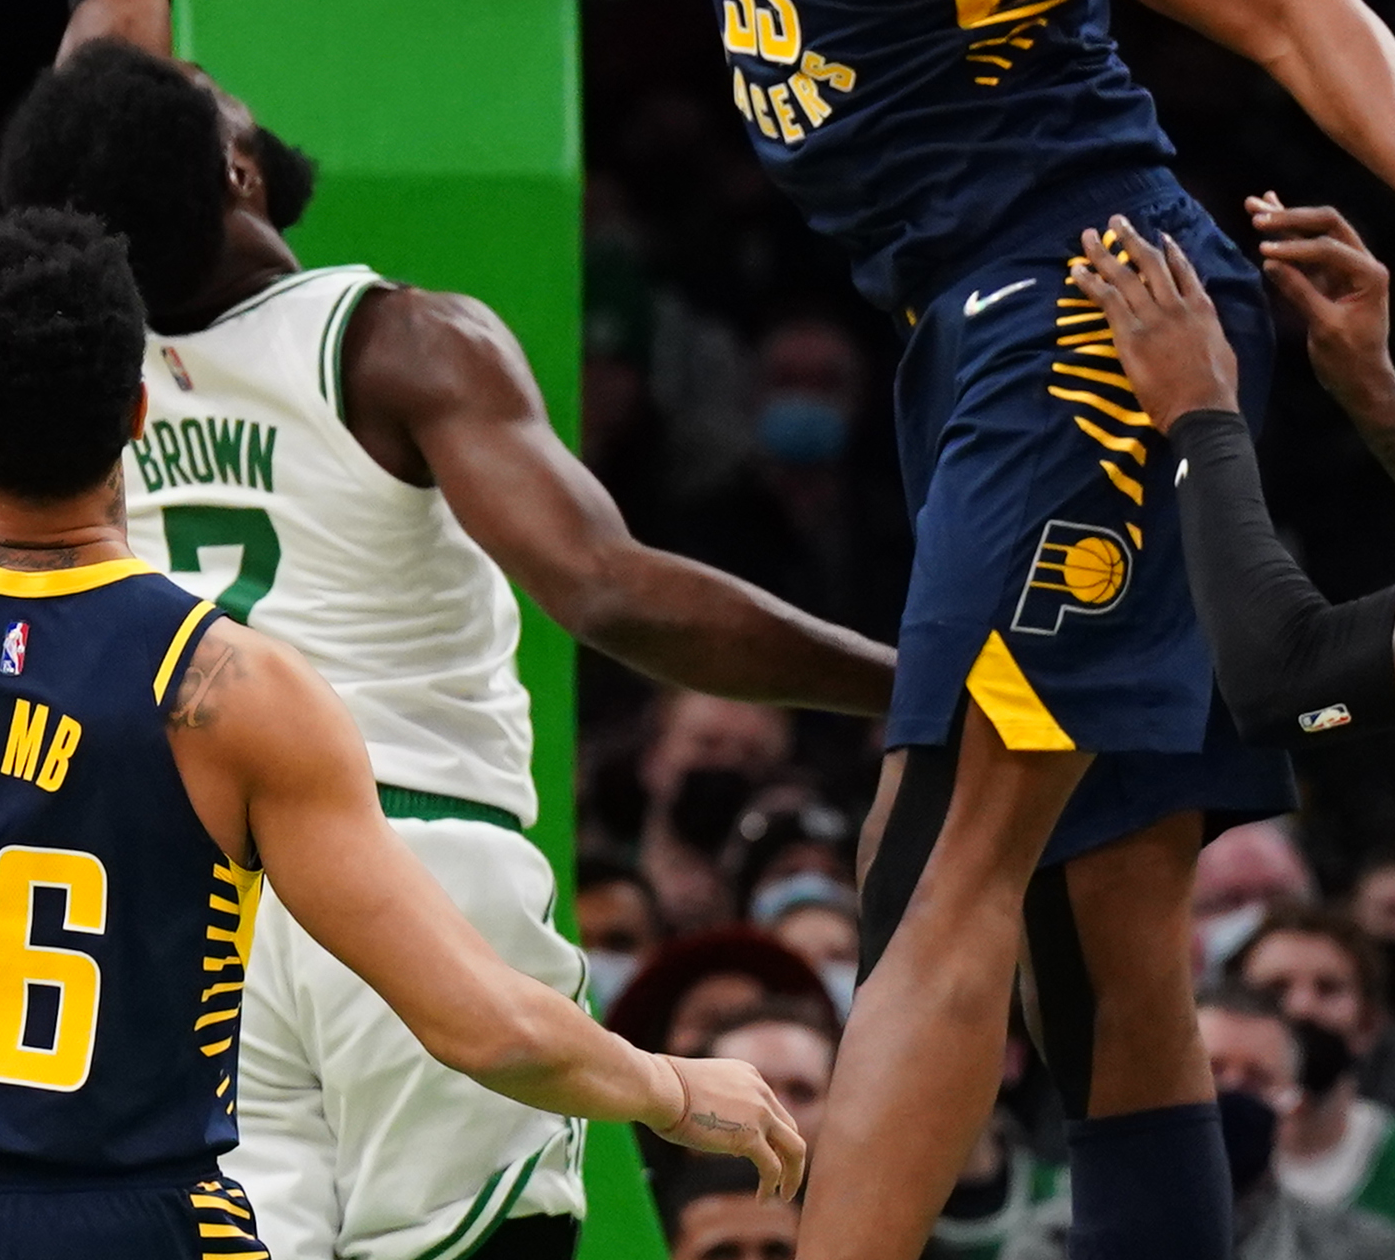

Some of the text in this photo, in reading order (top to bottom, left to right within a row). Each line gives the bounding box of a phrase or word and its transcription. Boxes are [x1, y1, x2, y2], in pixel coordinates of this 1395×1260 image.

[733, 50, 856, 145] ACERS
[131, 417, 277, 493] BROWN
[161, 505, 281, 626] 7
